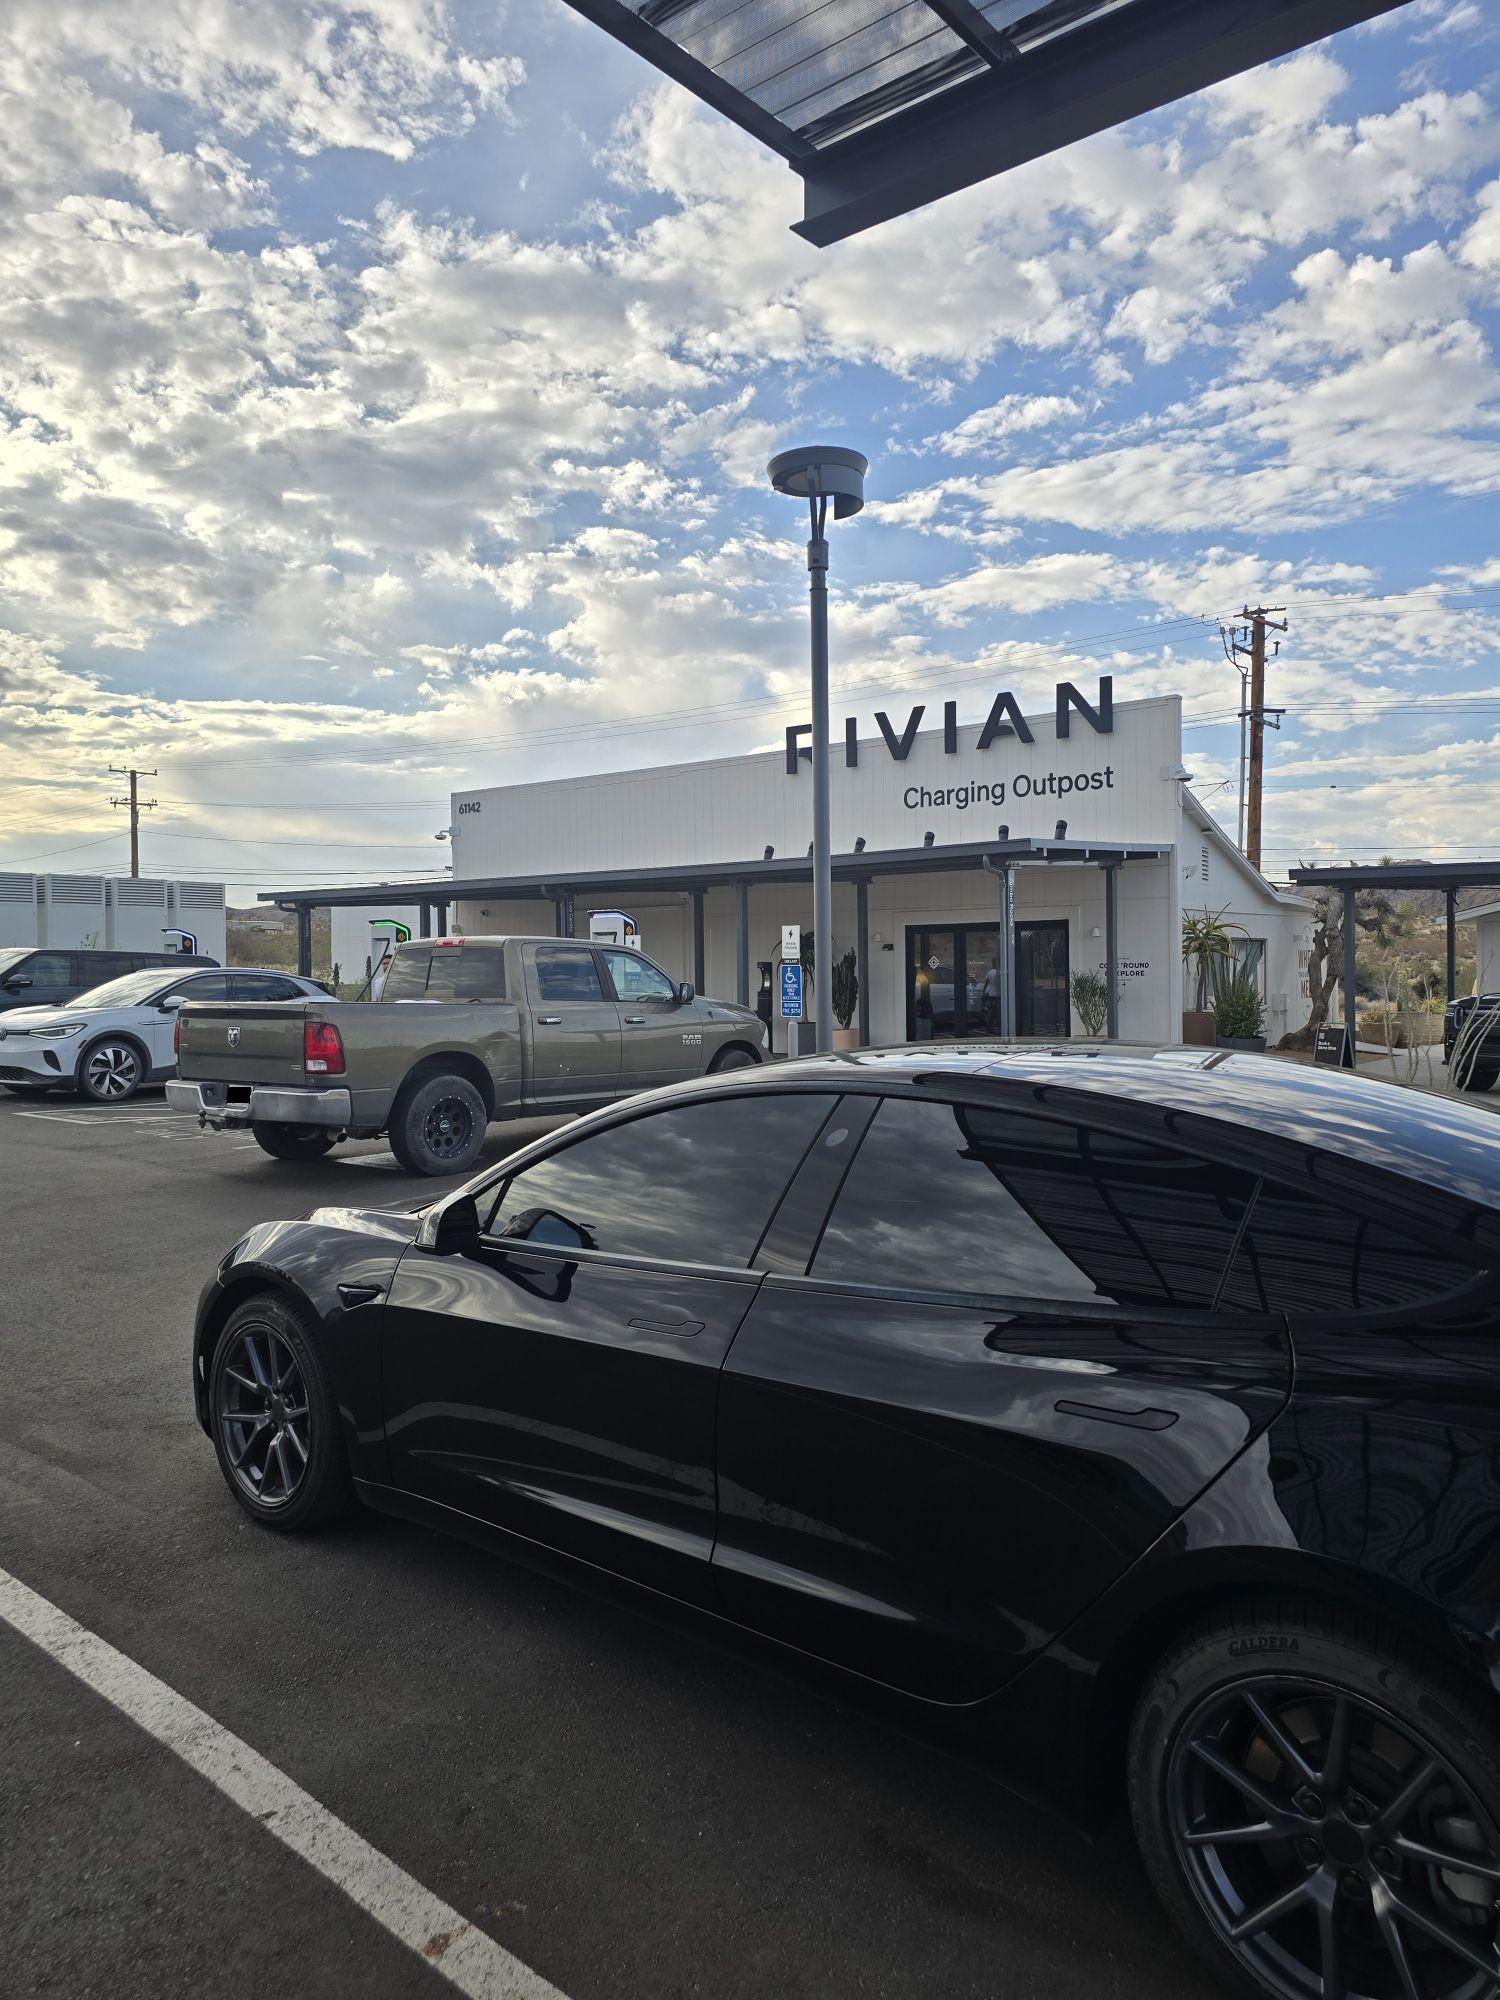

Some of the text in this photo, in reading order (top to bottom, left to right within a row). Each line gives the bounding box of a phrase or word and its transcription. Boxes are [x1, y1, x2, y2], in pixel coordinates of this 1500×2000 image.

[903, 766, 1114, 810] Charging Outpost
[458, 801, 481, 815] 61142
[1228, 1636, 1300, 1653] CALDERA
